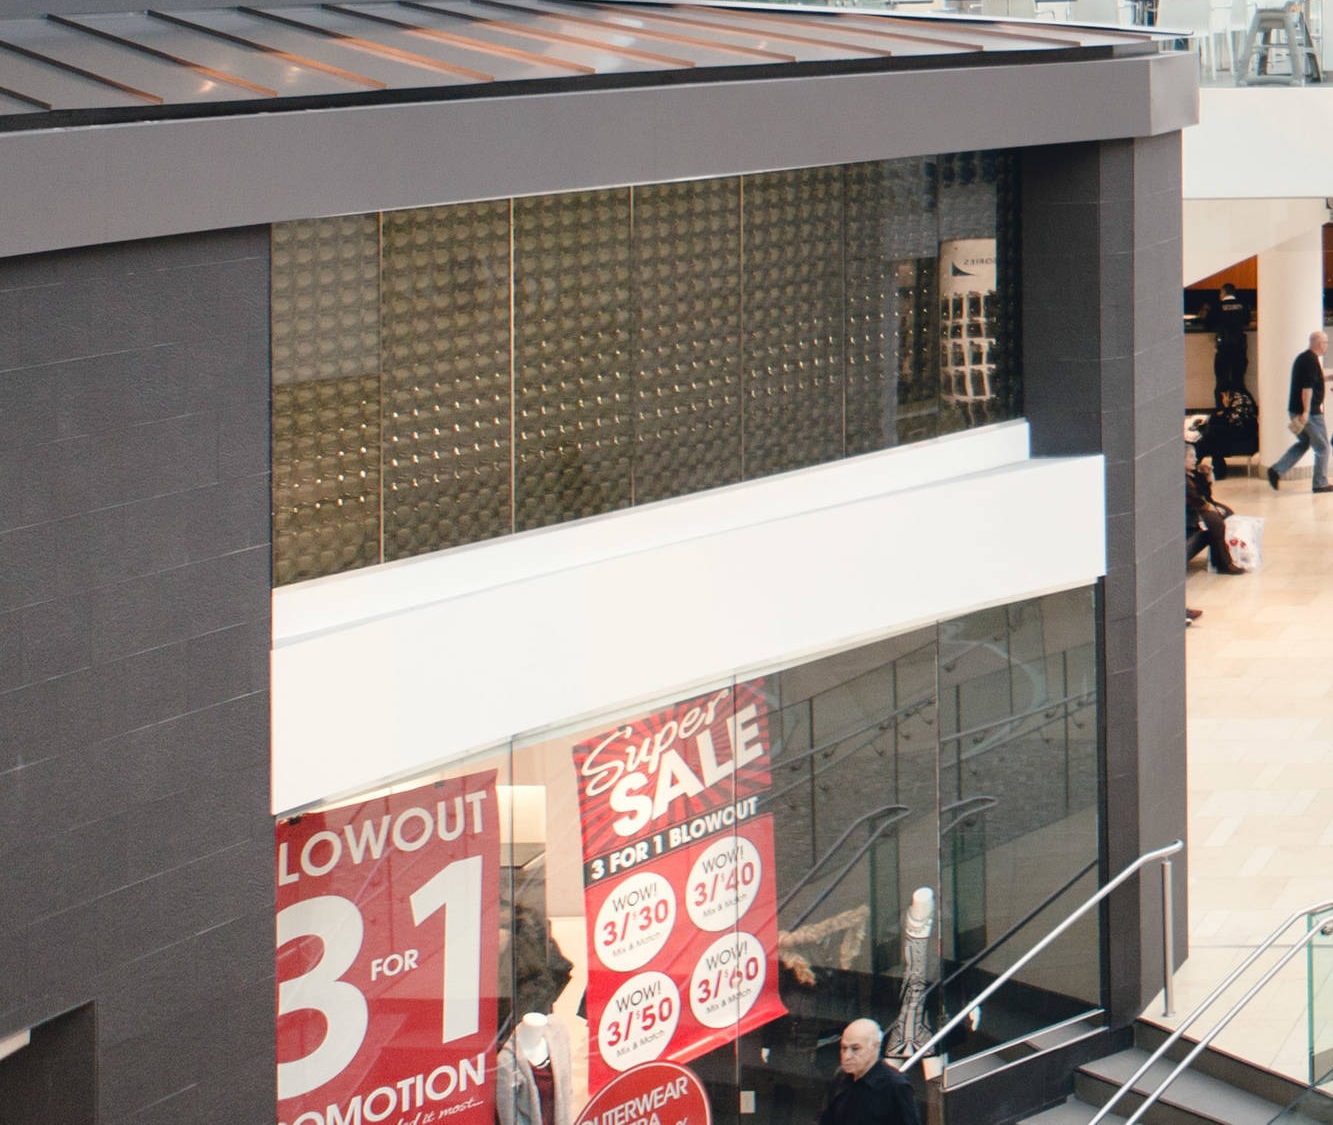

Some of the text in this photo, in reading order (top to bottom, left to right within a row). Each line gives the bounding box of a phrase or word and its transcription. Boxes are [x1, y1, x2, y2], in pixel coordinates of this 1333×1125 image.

[581, 689, 730, 797] Super
[609, 704, 765, 837] SALE
[278, 789, 487, 887] LOWOUT
[591, 795, 759, 880] 3 FOR 1 BLOWOUT
[703, 845, 744, 874] WOW!
[612, 883, 657, 913] WOW!
[276, 855, 483, 1101] 3 FOR 1
[616, 979, 662, 1013] WOW!
[706, 940, 748, 972] WOW!
